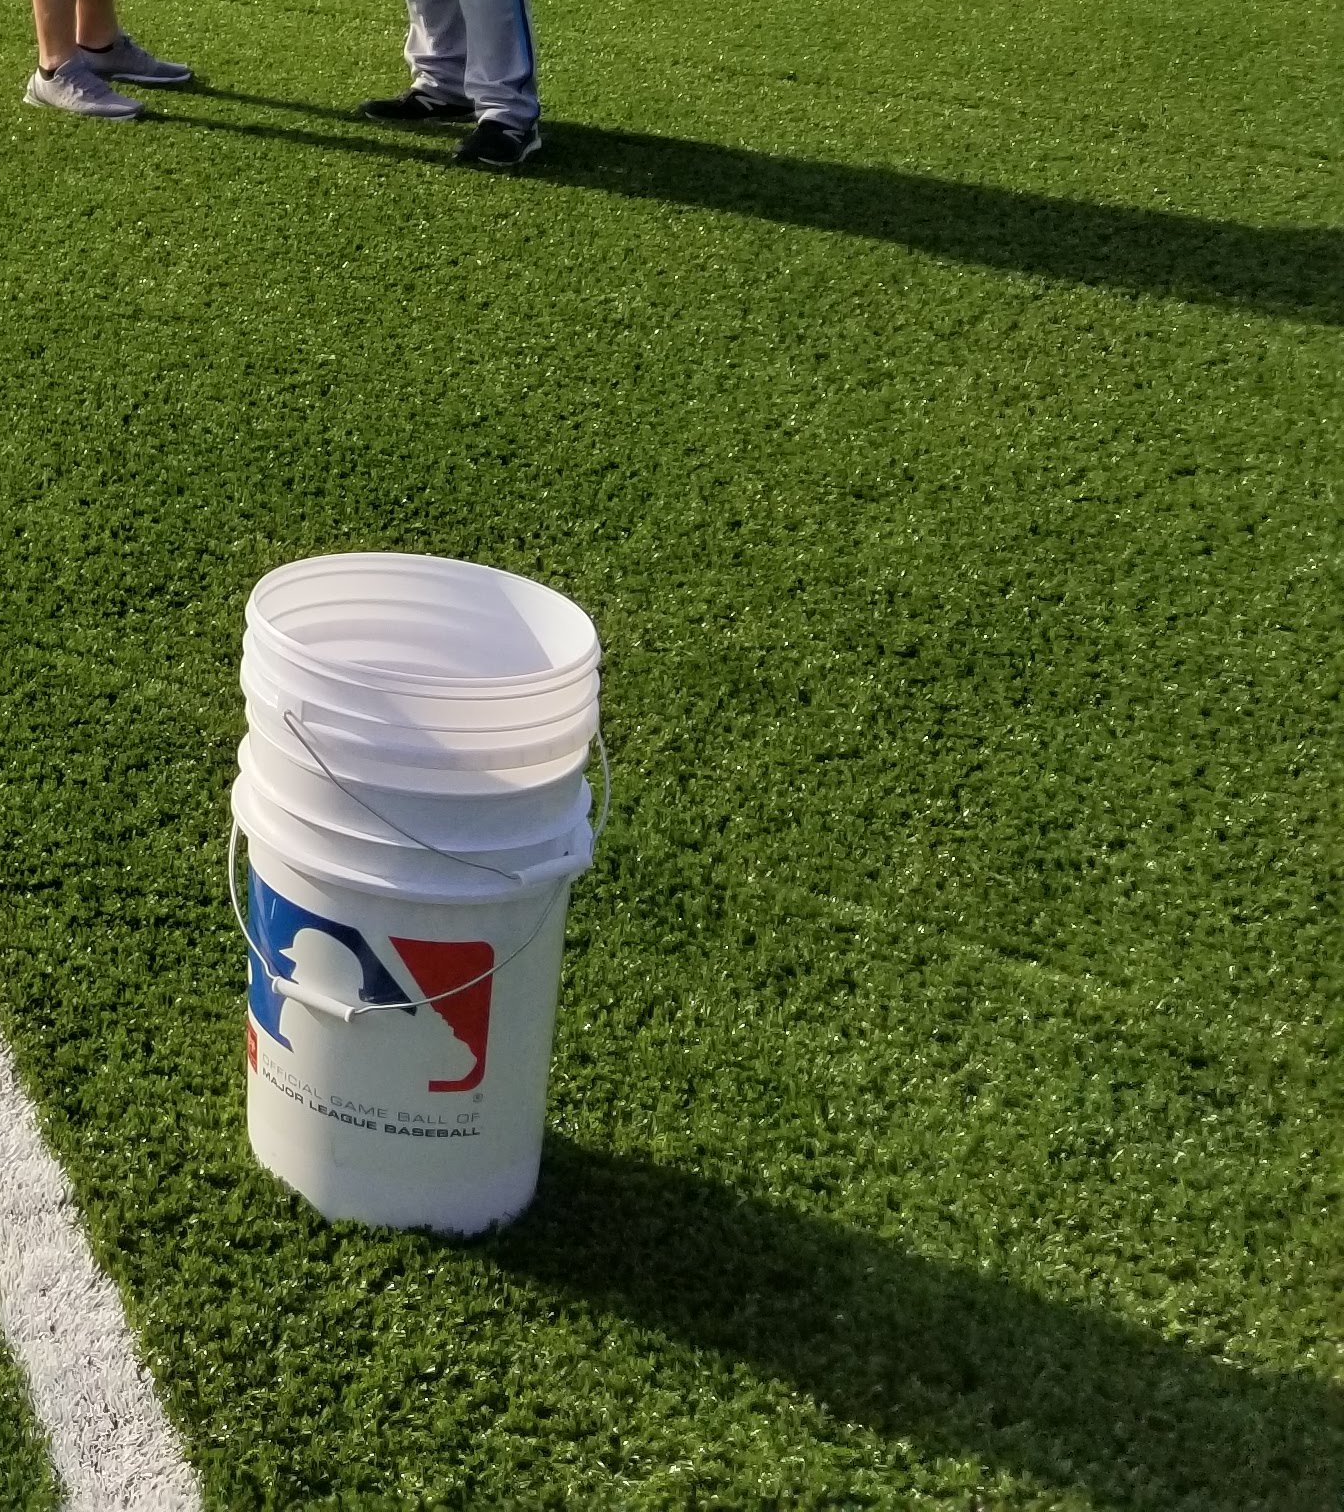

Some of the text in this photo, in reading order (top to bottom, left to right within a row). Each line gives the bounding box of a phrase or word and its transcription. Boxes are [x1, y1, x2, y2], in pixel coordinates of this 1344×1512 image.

[262, 1053, 480, 1125] OFFICIAL GAME BALL OF
[262, 1068, 480, 1138] MAJOR LEAGUE BASEBALL
